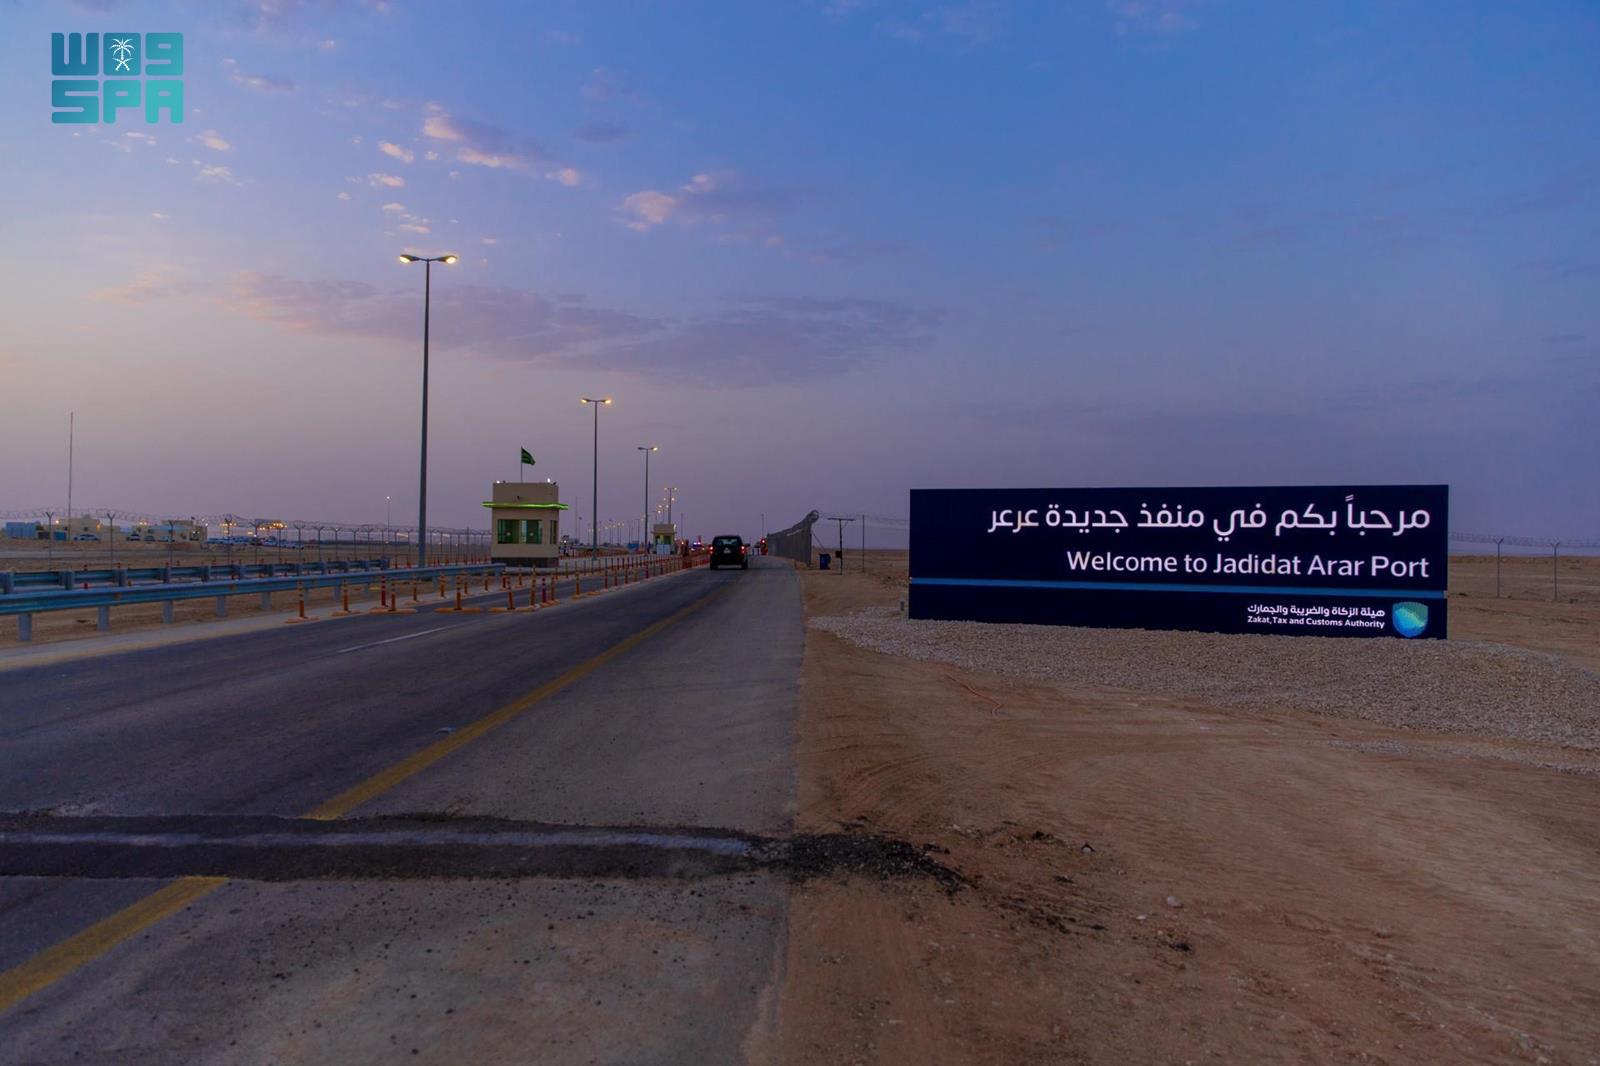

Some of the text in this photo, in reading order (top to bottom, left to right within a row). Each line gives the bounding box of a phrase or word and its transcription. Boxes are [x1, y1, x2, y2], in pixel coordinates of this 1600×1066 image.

[987, 509, 1040, 534] عرعر
[1046, 503, 1129, 534] جديدة
[1136, 502, 1205, 528] منفذ
[1213, 502, 1267, 542] في
[1275, 503, 1338, 537] بكم
[1066, 550, 1430, 578] Welcome to Jadidat Arar Port
[1247, 604, 1386, 619] هيئة الزكاة والضريبة والجمارك
[1289, 617, 1304, 625] and
[1305, 617, 1343, 627] Customs
[1344, 618, 1385, 630] Authority
